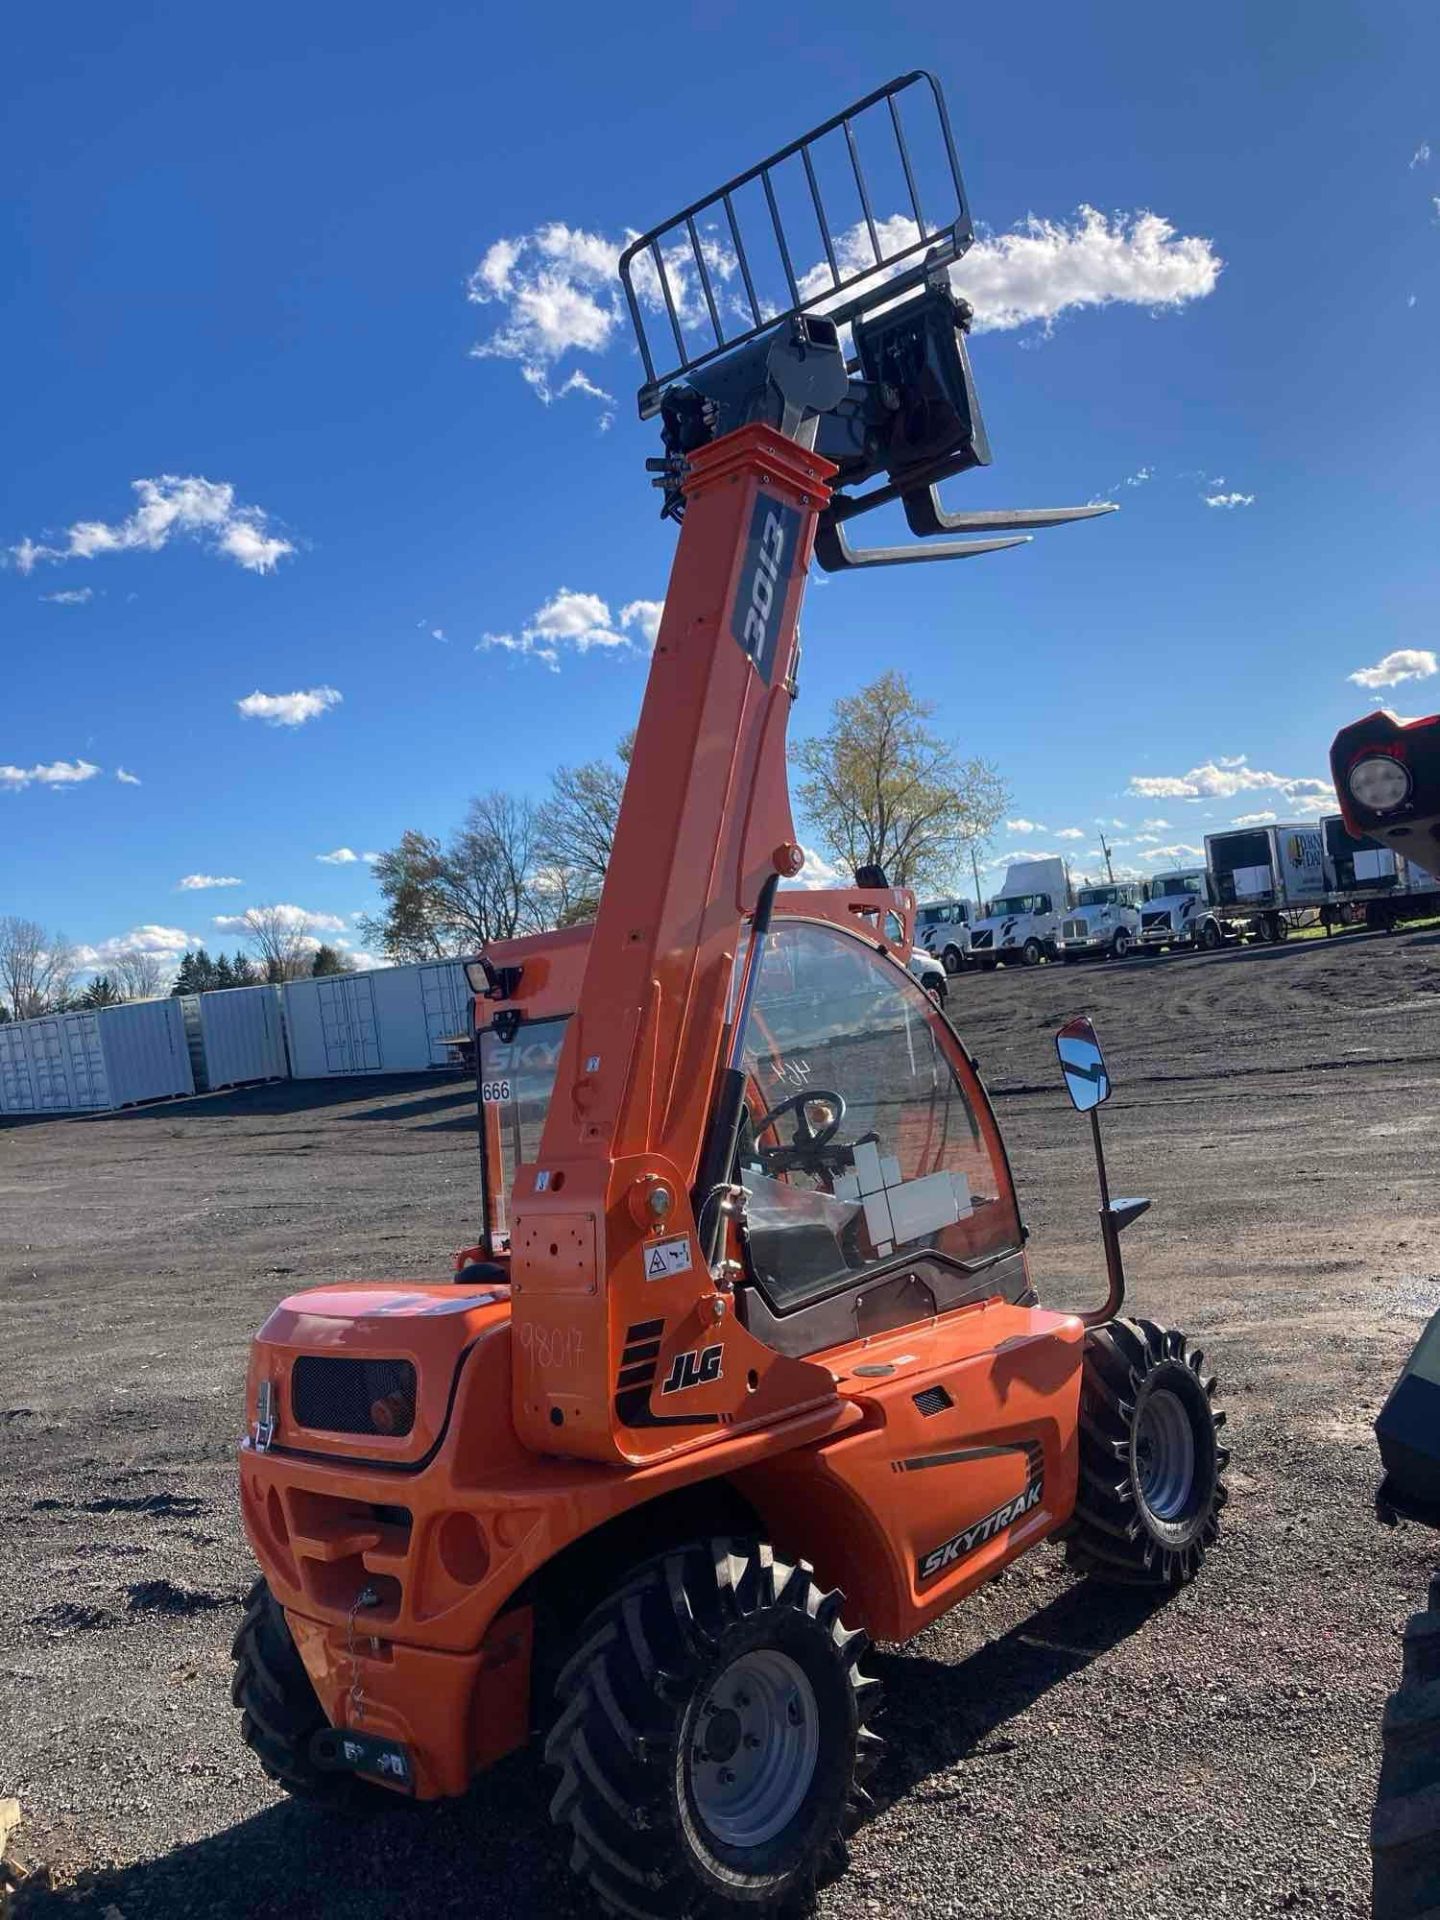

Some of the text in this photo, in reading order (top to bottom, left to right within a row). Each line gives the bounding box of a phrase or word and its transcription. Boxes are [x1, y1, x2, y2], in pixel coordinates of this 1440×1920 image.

[744, 511, 784, 661] 3013
[483, 1081, 510, 1101] 666
[661, 1343, 724, 1395] JLG
[922, 1482, 1042, 1578] SKYTRAK
